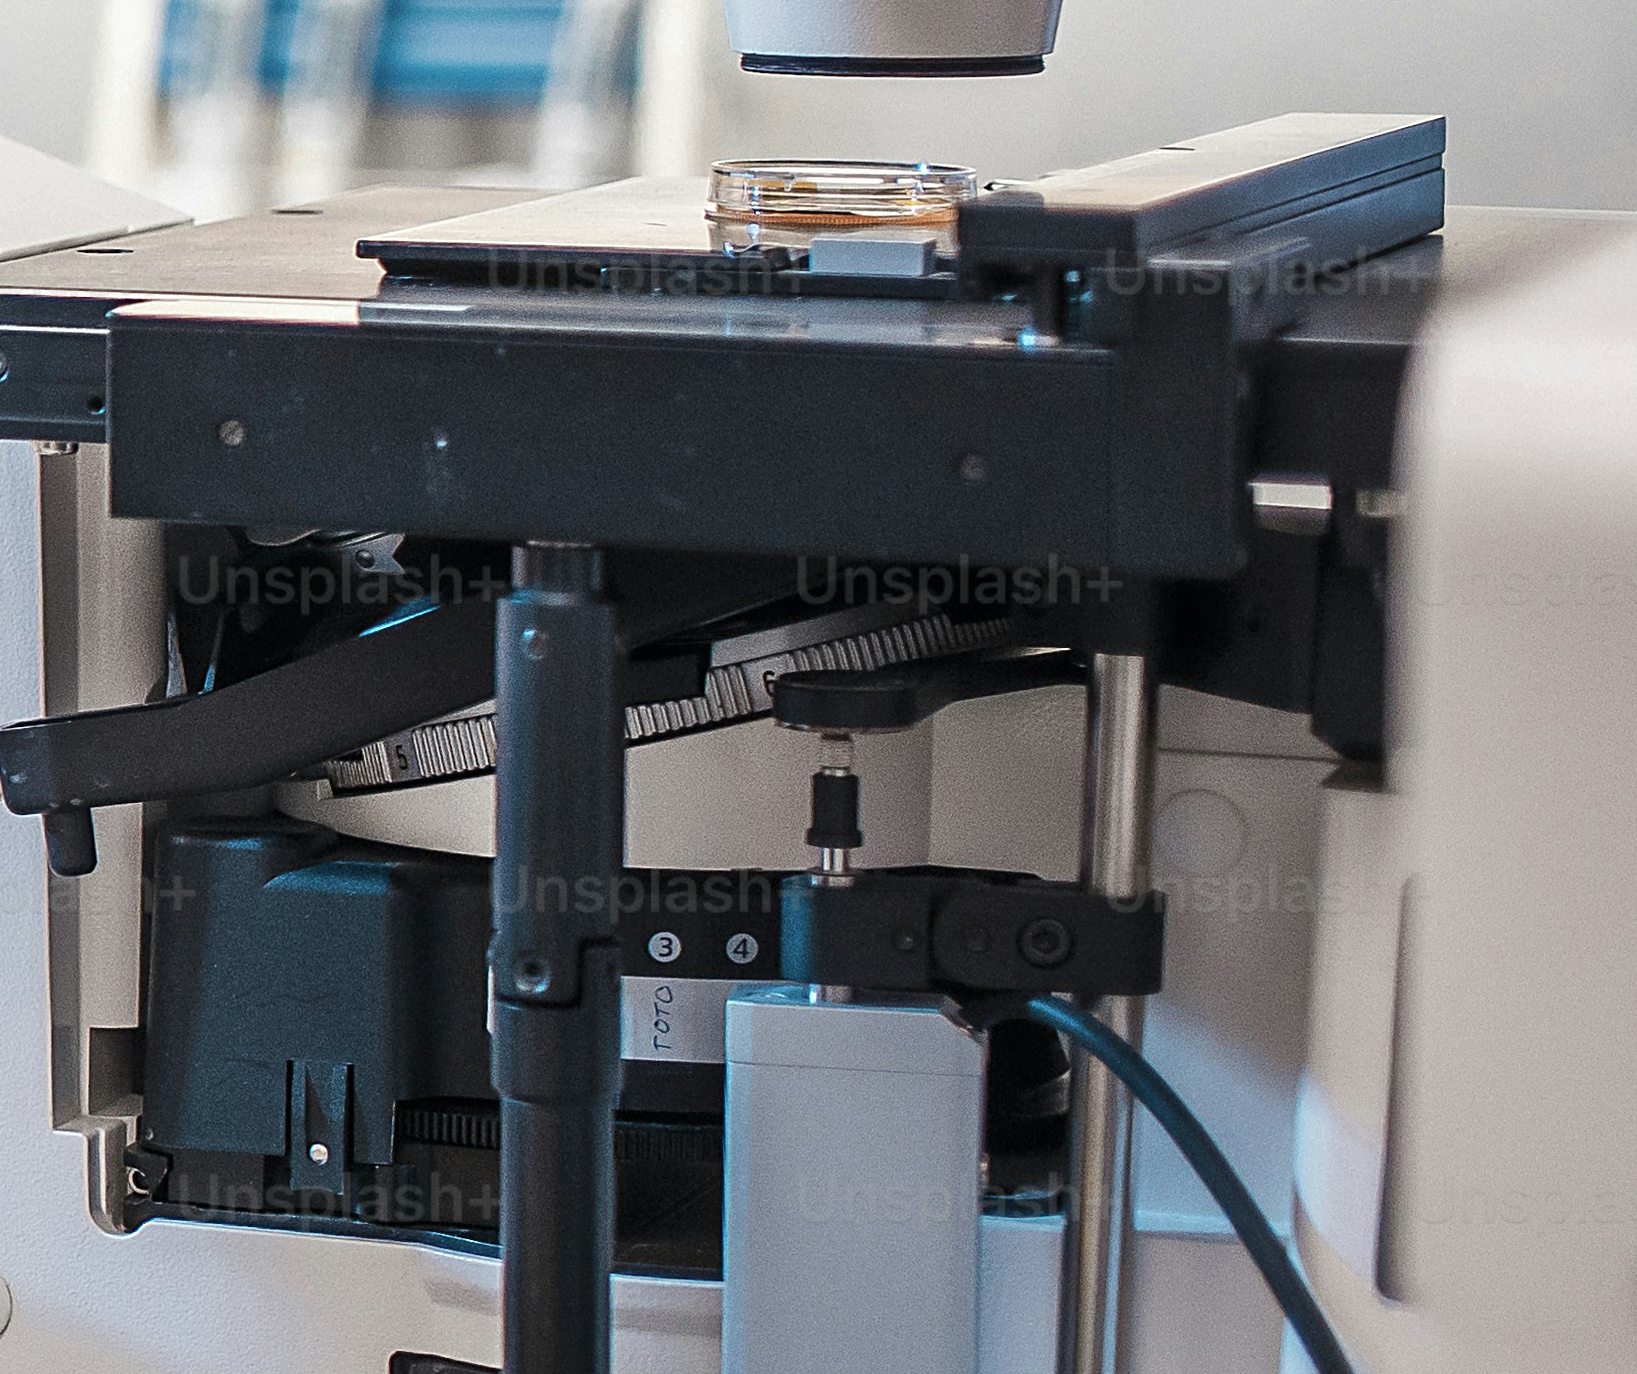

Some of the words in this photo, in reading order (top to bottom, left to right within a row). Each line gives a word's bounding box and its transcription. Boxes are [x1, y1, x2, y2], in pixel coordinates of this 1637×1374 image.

[394, 744, 409, 771] 5
[657, 936, 675, 958] 3
[732, 937, 750, 959] 4
[653, 985, 674, 1051] TOTO
